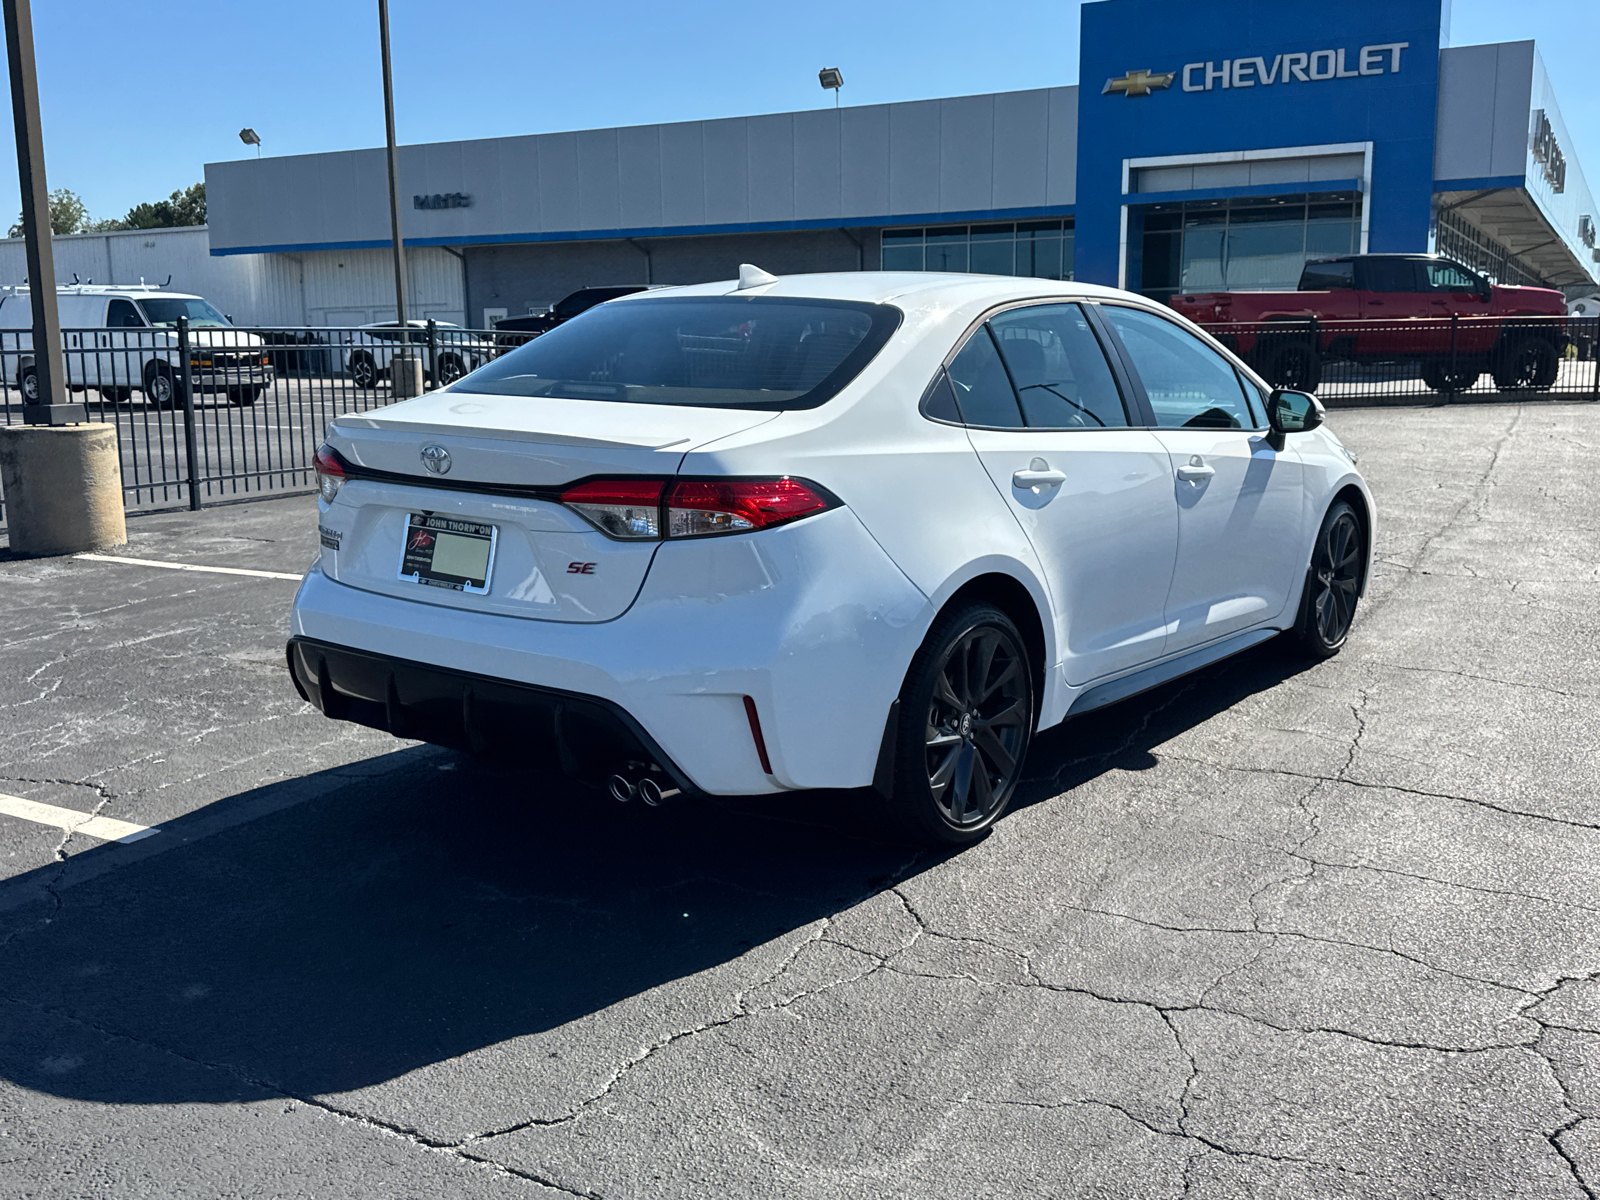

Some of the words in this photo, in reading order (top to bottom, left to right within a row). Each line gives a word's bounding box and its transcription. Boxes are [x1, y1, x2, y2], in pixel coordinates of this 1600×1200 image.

[1181, 42, 1409, 92] CHEVROLET
[425, 518, 447, 529] JOHN
[566, 561, 597, 574] SE
